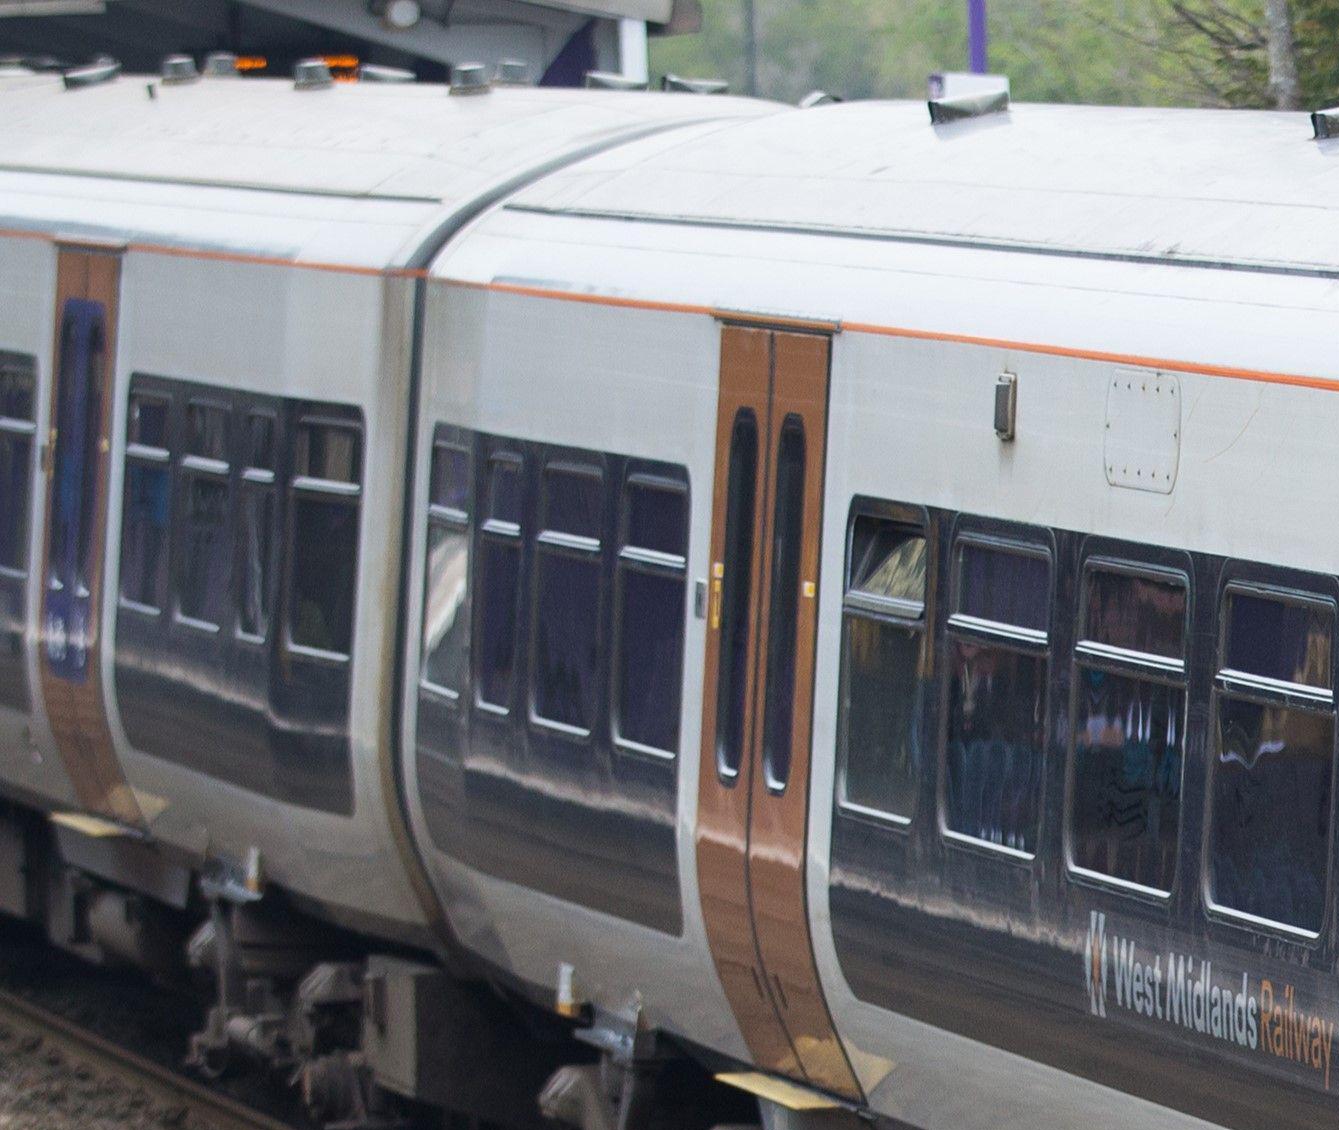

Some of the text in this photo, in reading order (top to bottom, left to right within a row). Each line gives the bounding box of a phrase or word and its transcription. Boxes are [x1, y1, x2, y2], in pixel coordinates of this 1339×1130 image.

[1112, 935, 1334, 1091] West Midlands Railway
